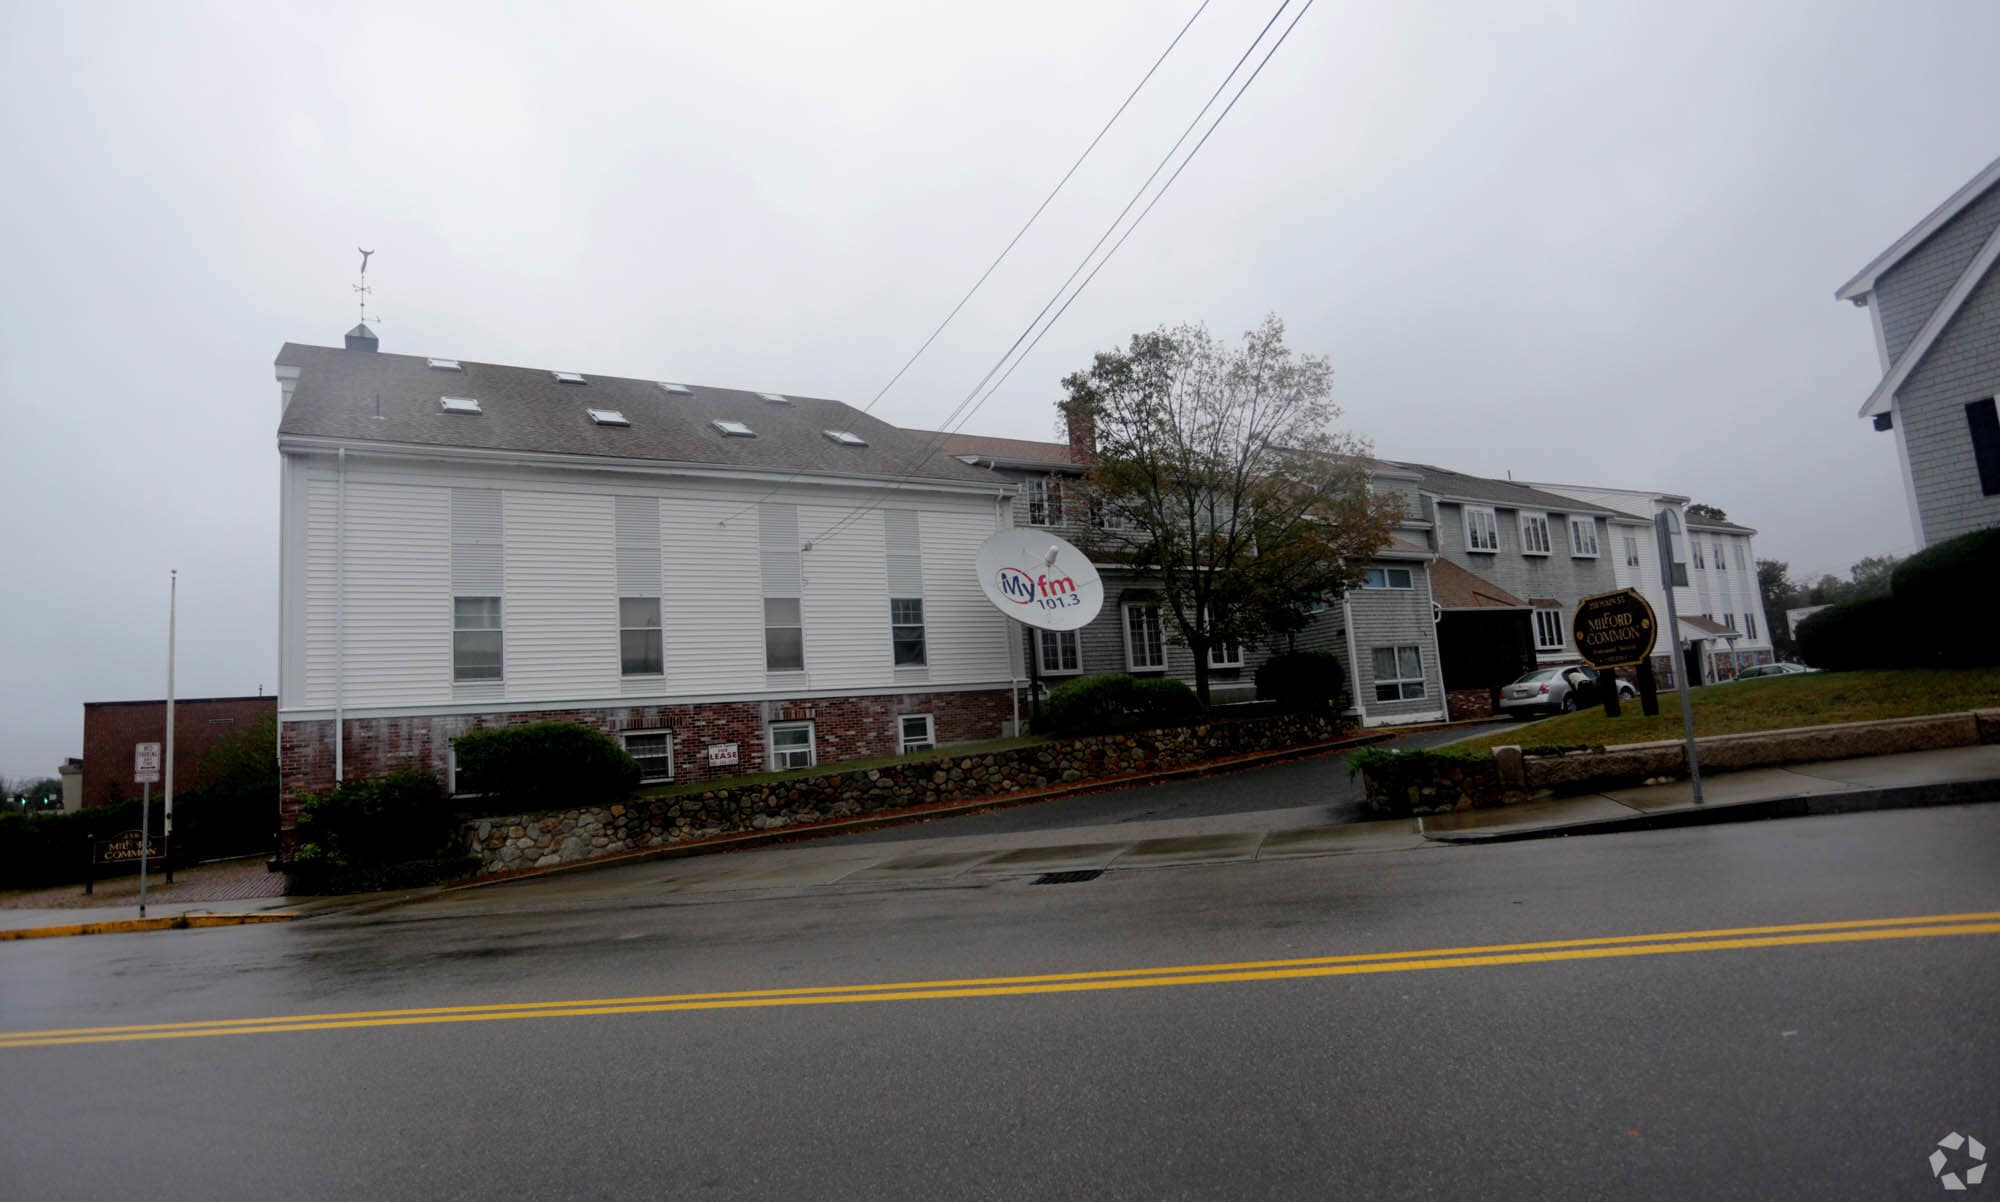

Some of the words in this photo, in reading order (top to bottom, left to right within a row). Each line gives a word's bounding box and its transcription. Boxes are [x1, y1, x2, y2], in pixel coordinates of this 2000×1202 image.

[1037, 593, 1081, 610] 101.3
[1588, 611, 1633, 632] MILFORD
[1586, 625, 1640, 646] COMMON
[710, 752, 737, 760] LEASE
[103, 848, 157, 860] COMMN
